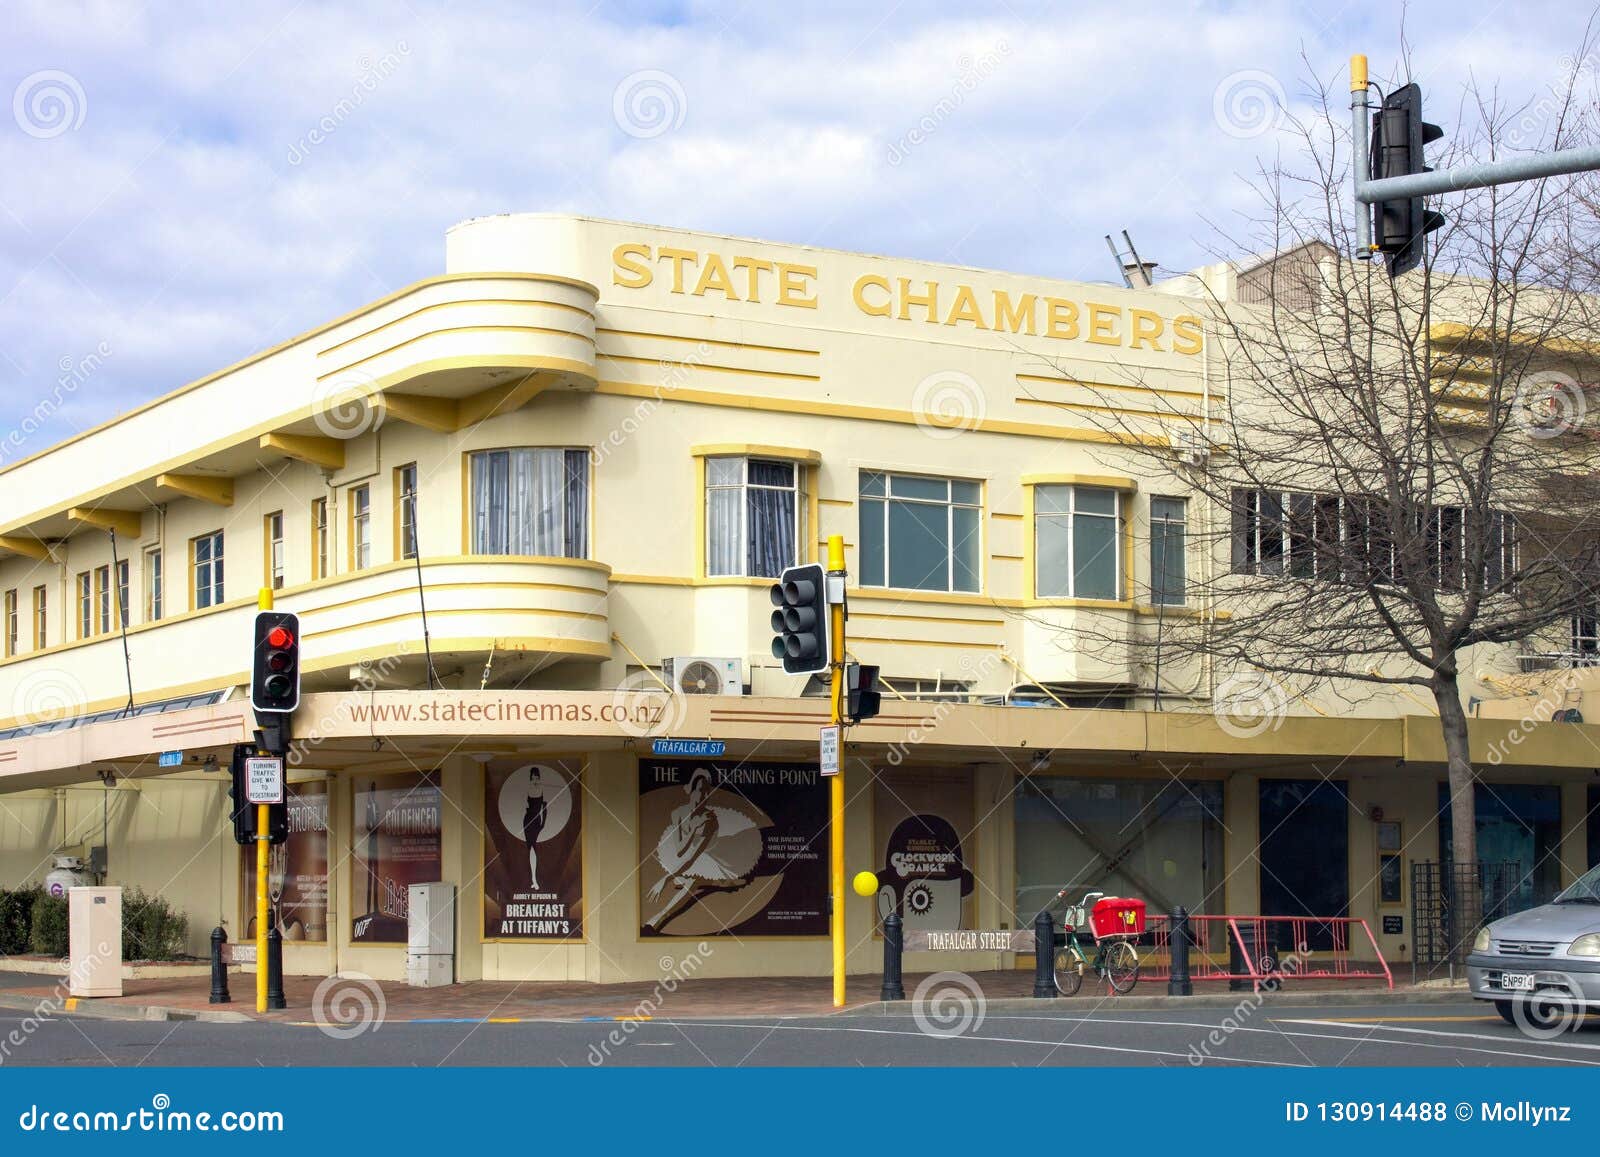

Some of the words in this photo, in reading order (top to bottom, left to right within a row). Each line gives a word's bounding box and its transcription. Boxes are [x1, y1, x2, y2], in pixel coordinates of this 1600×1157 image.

[612, 243, 818, 309] STATE
[853, 274, 1204, 355] CHAMBERS
[350, 699, 661, 723] www.statecinemas.co.nz
[657, 742, 707, 753] TRAFALGAR
[710, 743, 722, 754] ST
[653, 766, 680, 783] THE
[717, 768, 775, 785] TURNING
[780, 770, 819, 785] POINT
[891, 852, 955, 868] CLOCKWORK
[896, 862, 946, 877] ORANGE
[506, 904, 565, 917] BREAKFAST
[501, 921, 514, 933] AT
[517, 921, 570, 934] TIFFANY'S
[928, 932, 977, 950] TRAFALGAR
[980, 932, 1011, 950] STREET
